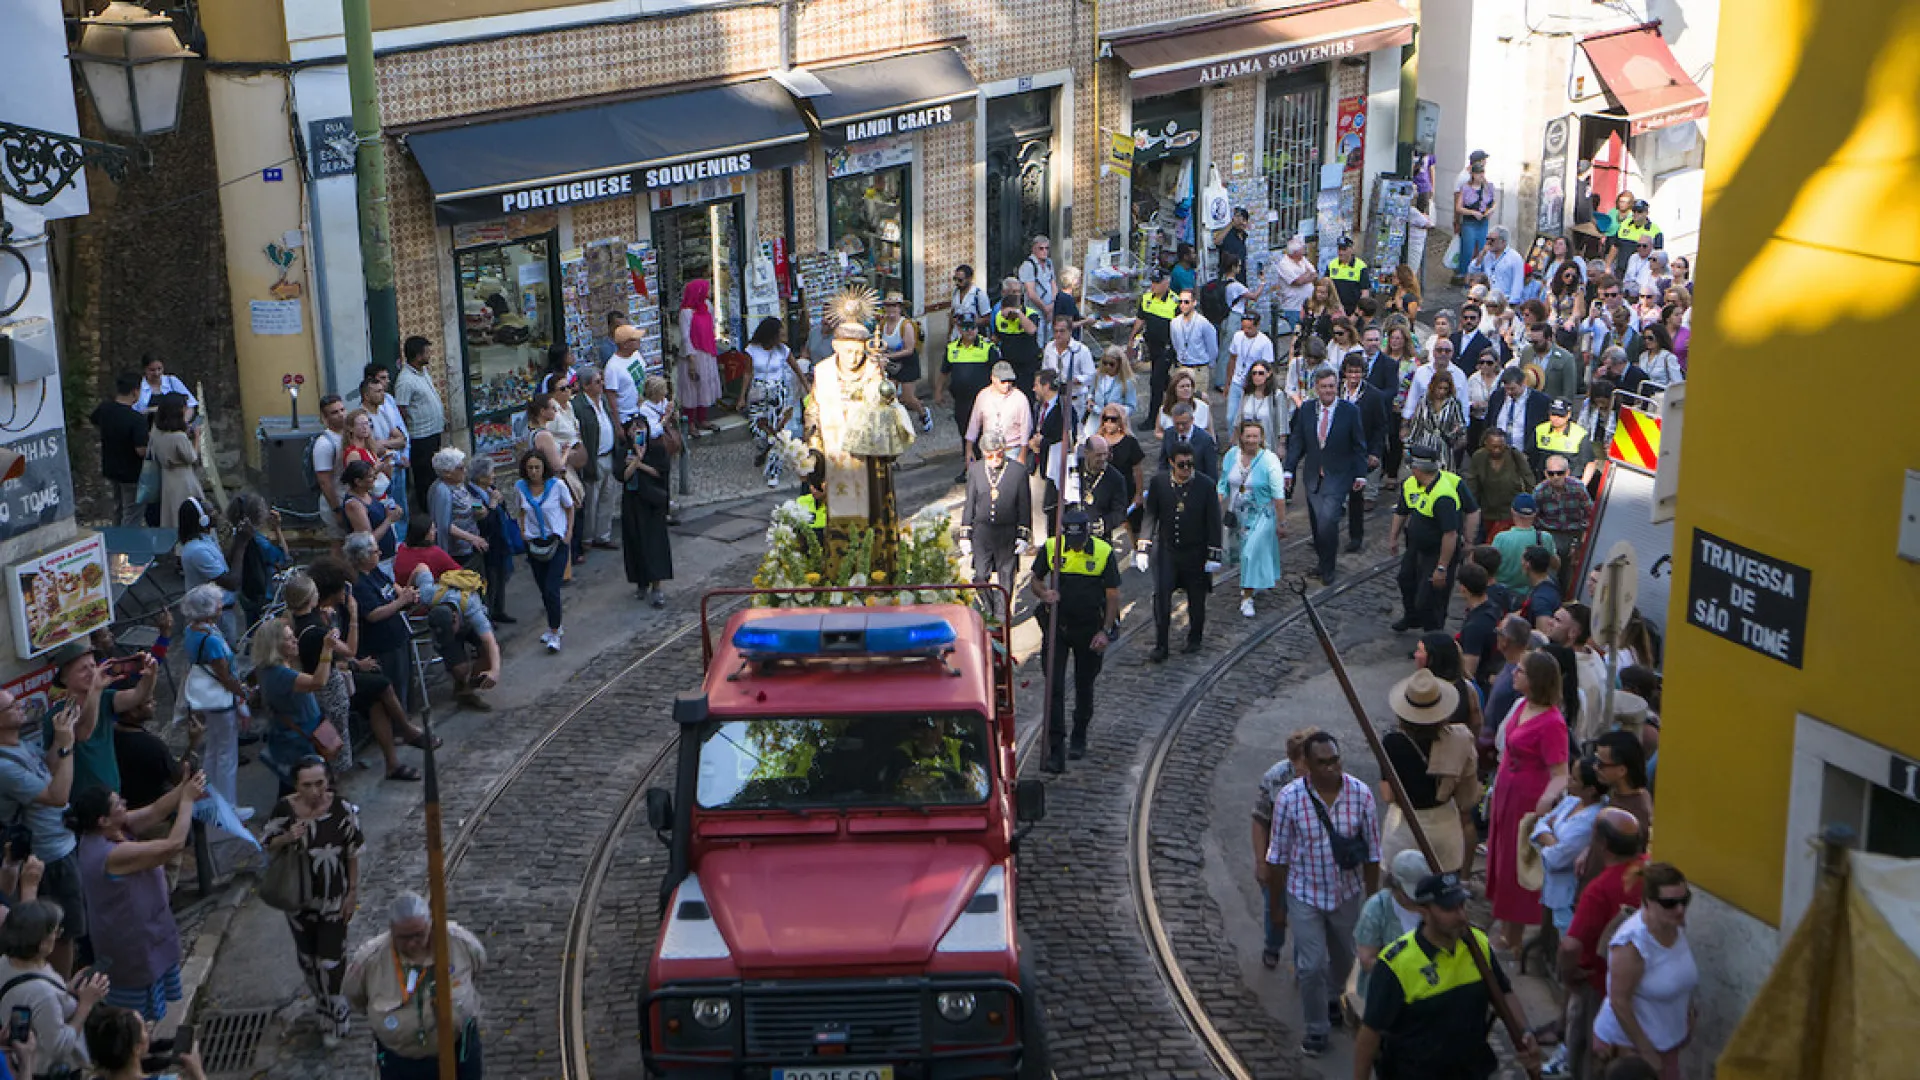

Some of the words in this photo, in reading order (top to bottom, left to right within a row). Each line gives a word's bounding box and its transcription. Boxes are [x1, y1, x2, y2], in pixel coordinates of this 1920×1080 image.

[1199, 57, 1263, 83] ALFAMA
[1268, 39, 1355, 69] SOUVENIRS
[324, 121, 346, 134] RUA
[846, 116, 893, 141] HANDI
[897, 104, 952, 131] CRAFTS
[502, 173, 632, 213] PORTUGUESE
[646, 153, 751, 188] SOUVENIRS
[20, 480, 60, 516] TOMÉ
[1701, 538, 1795, 598] TRAVESSA
[1730, 582, 1756, 614] DE
[1694, 598, 1729, 632] SÃO
[1741, 617, 1791, 659] TOMÉ
